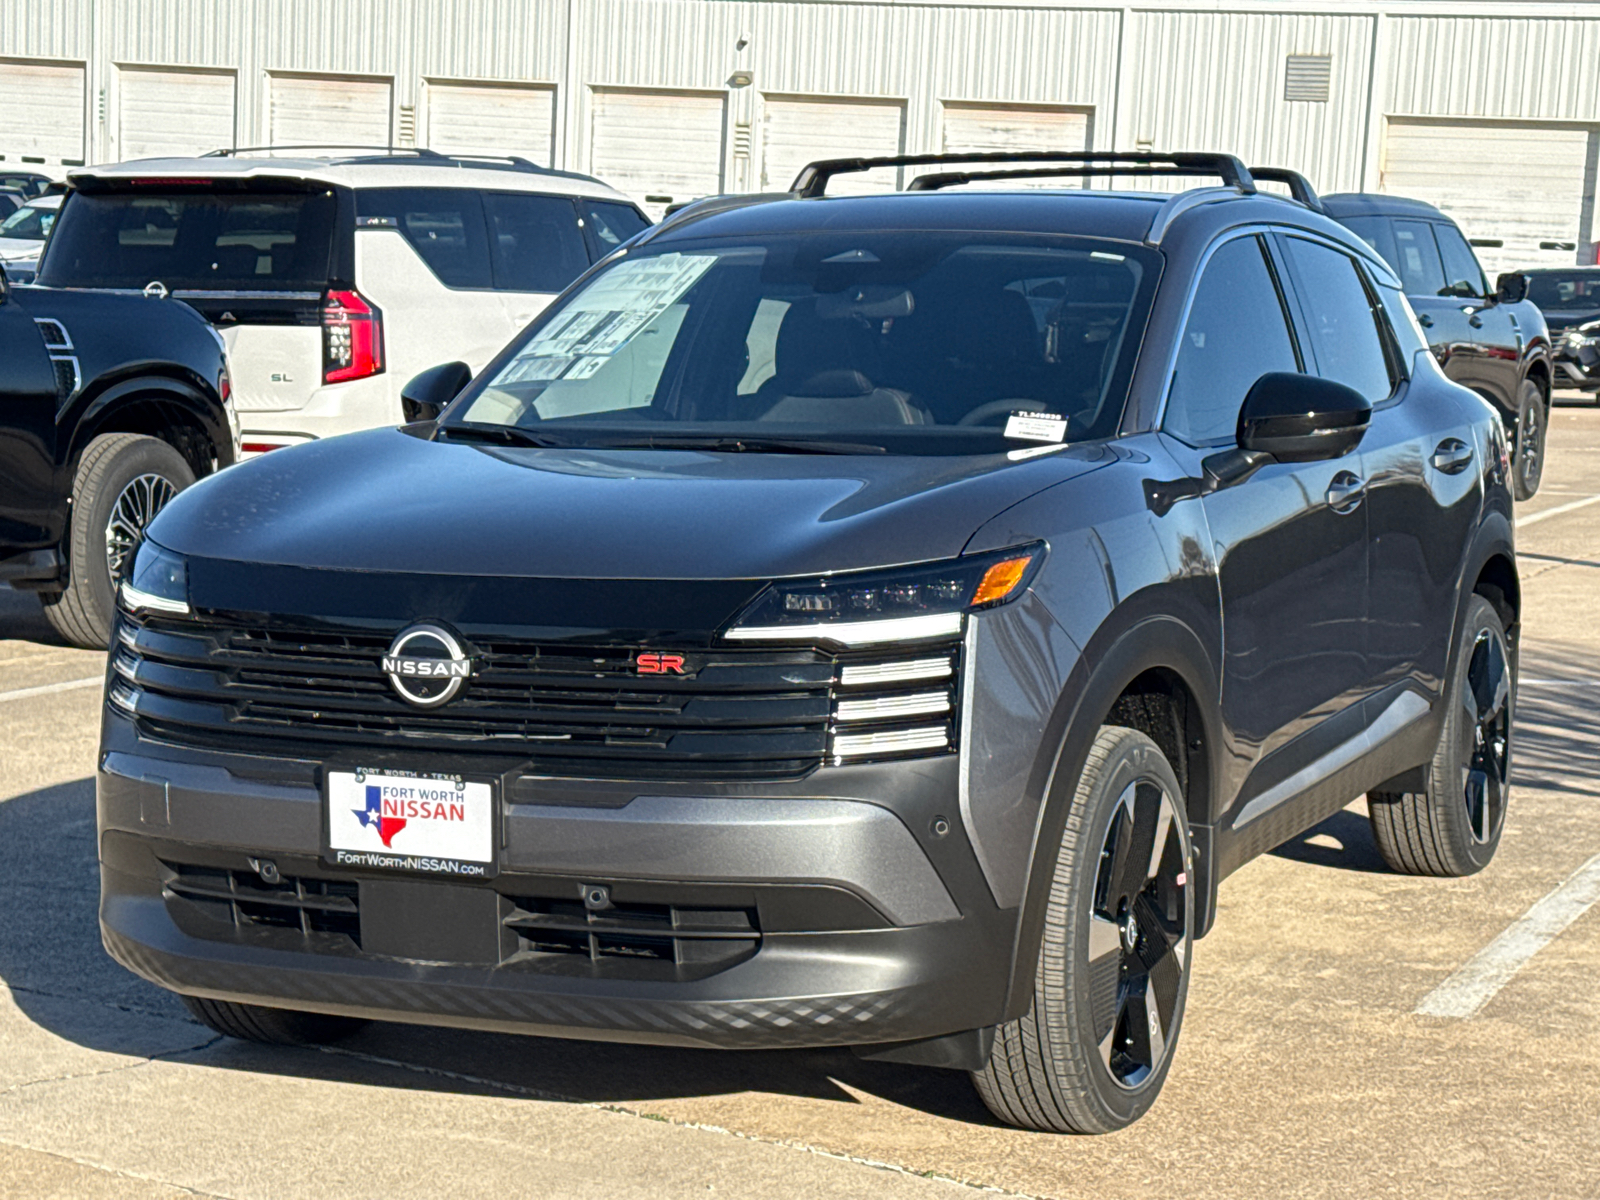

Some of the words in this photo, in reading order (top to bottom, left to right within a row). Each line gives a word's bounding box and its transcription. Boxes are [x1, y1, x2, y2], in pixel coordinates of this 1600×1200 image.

[271, 373, 293, 382] SL
[382, 658, 467, 675] NISSAN
[637, 654, 685, 673] SR
[356, 767, 380, 775] FORT
[384, 769, 418, 778] WORTH
[431, 773, 462, 782] TEXAS
[383, 786, 415, 799] FORT
[418, 789, 465, 803] WORTH
[383, 799, 465, 821] NISSAN
